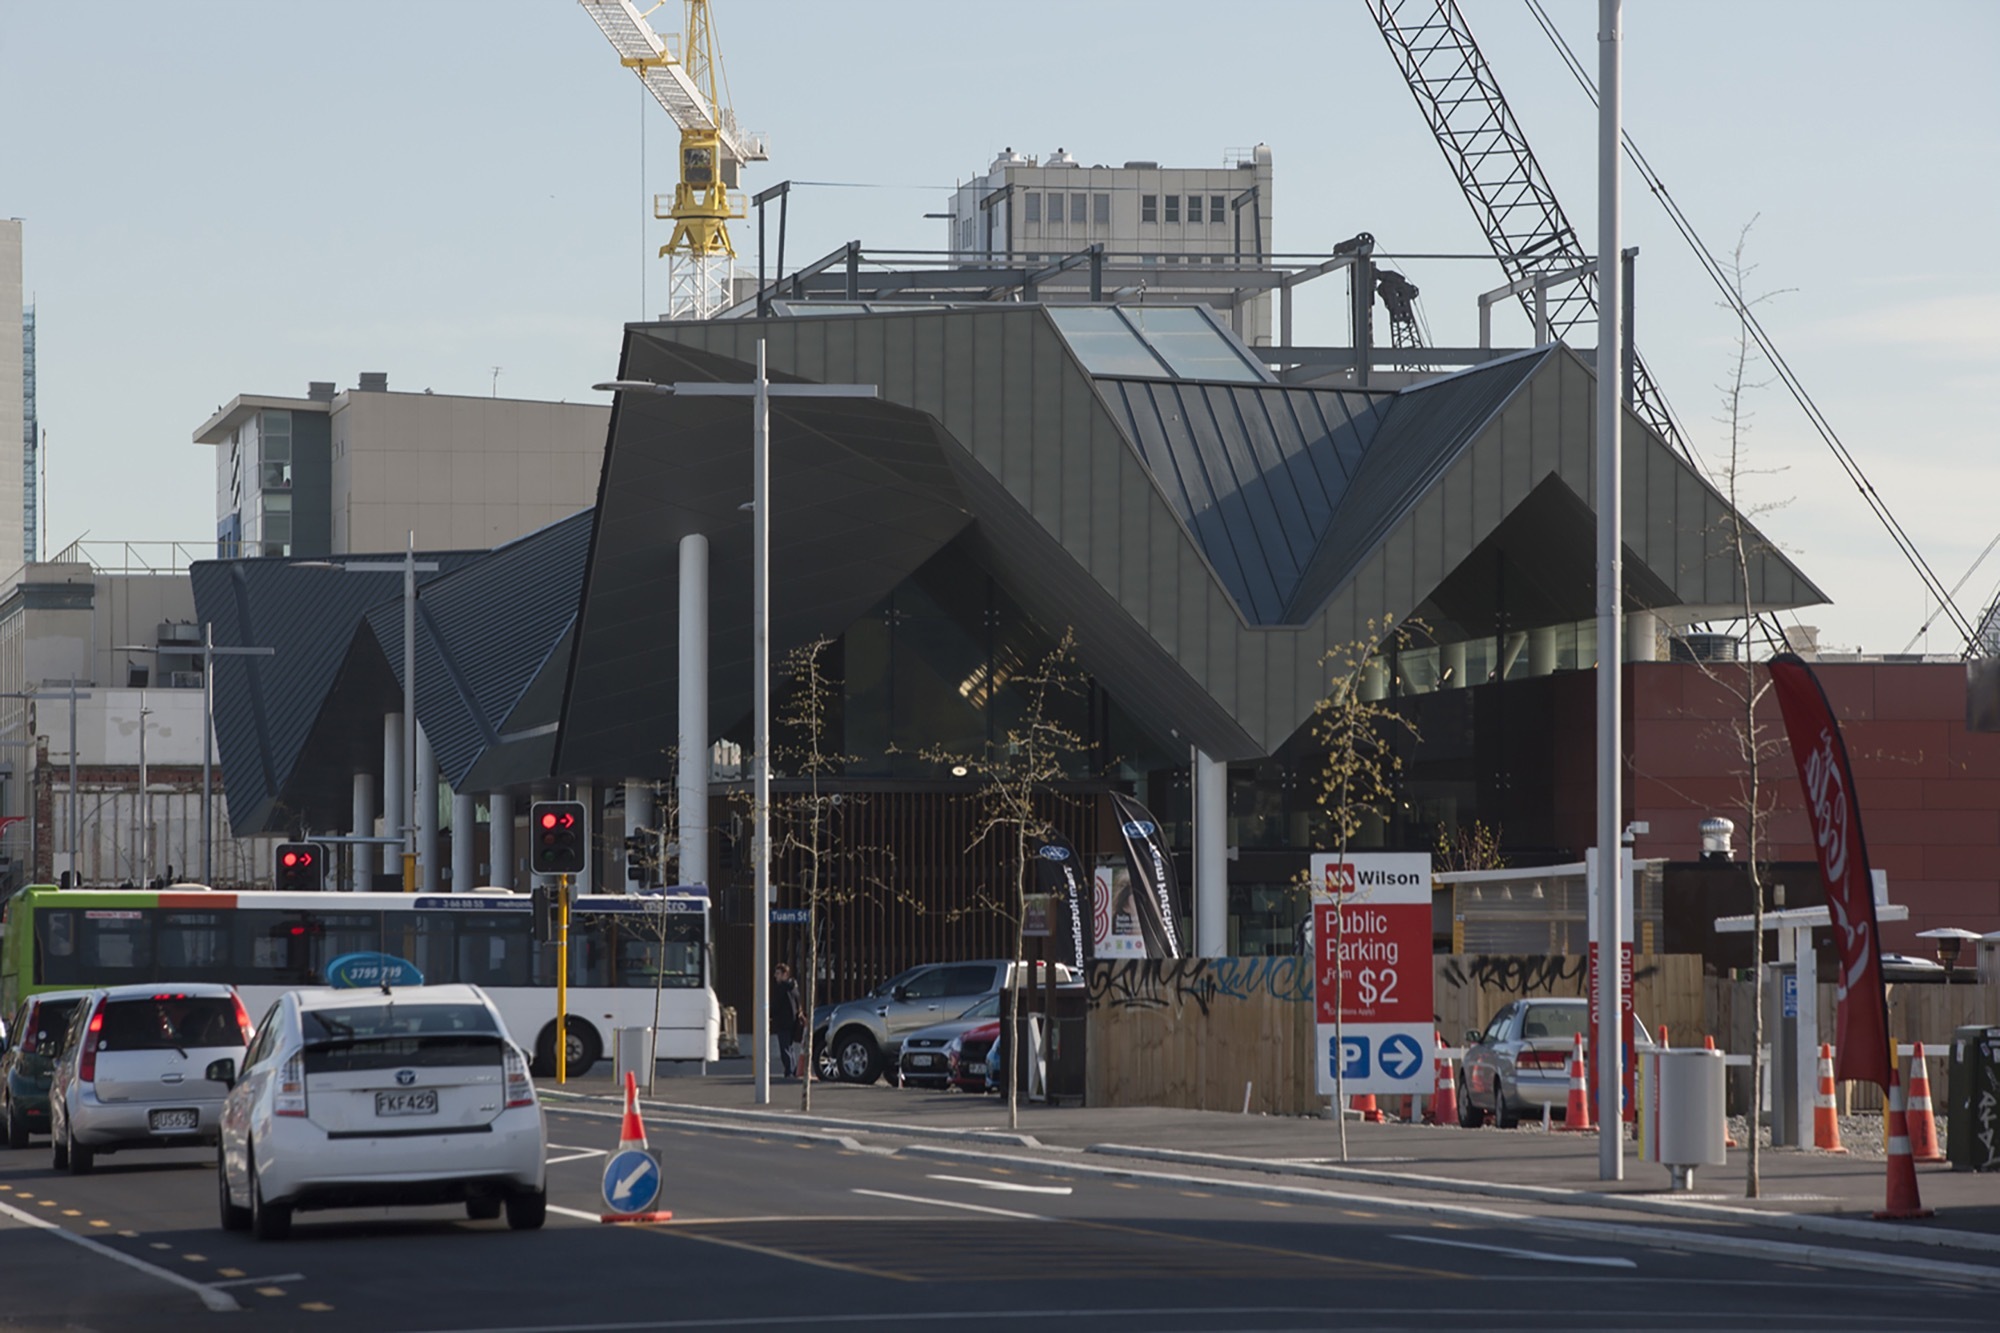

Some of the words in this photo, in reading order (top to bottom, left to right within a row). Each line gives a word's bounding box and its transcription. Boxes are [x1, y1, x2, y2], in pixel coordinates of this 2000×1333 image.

[1357, 870, 1420, 885] Wilson
[771, 911, 796, 921] Tuam
[797, 911, 807, 921] St
[1325, 910, 1388, 934] Public
[1326, 938, 1399, 966] Parking
[349, 967, 378, 980] 3799
[1326, 967, 1352, 980] Frm
[1358, 966, 1399, 1008] $2
[379, 1095, 435, 1111] FKF429
